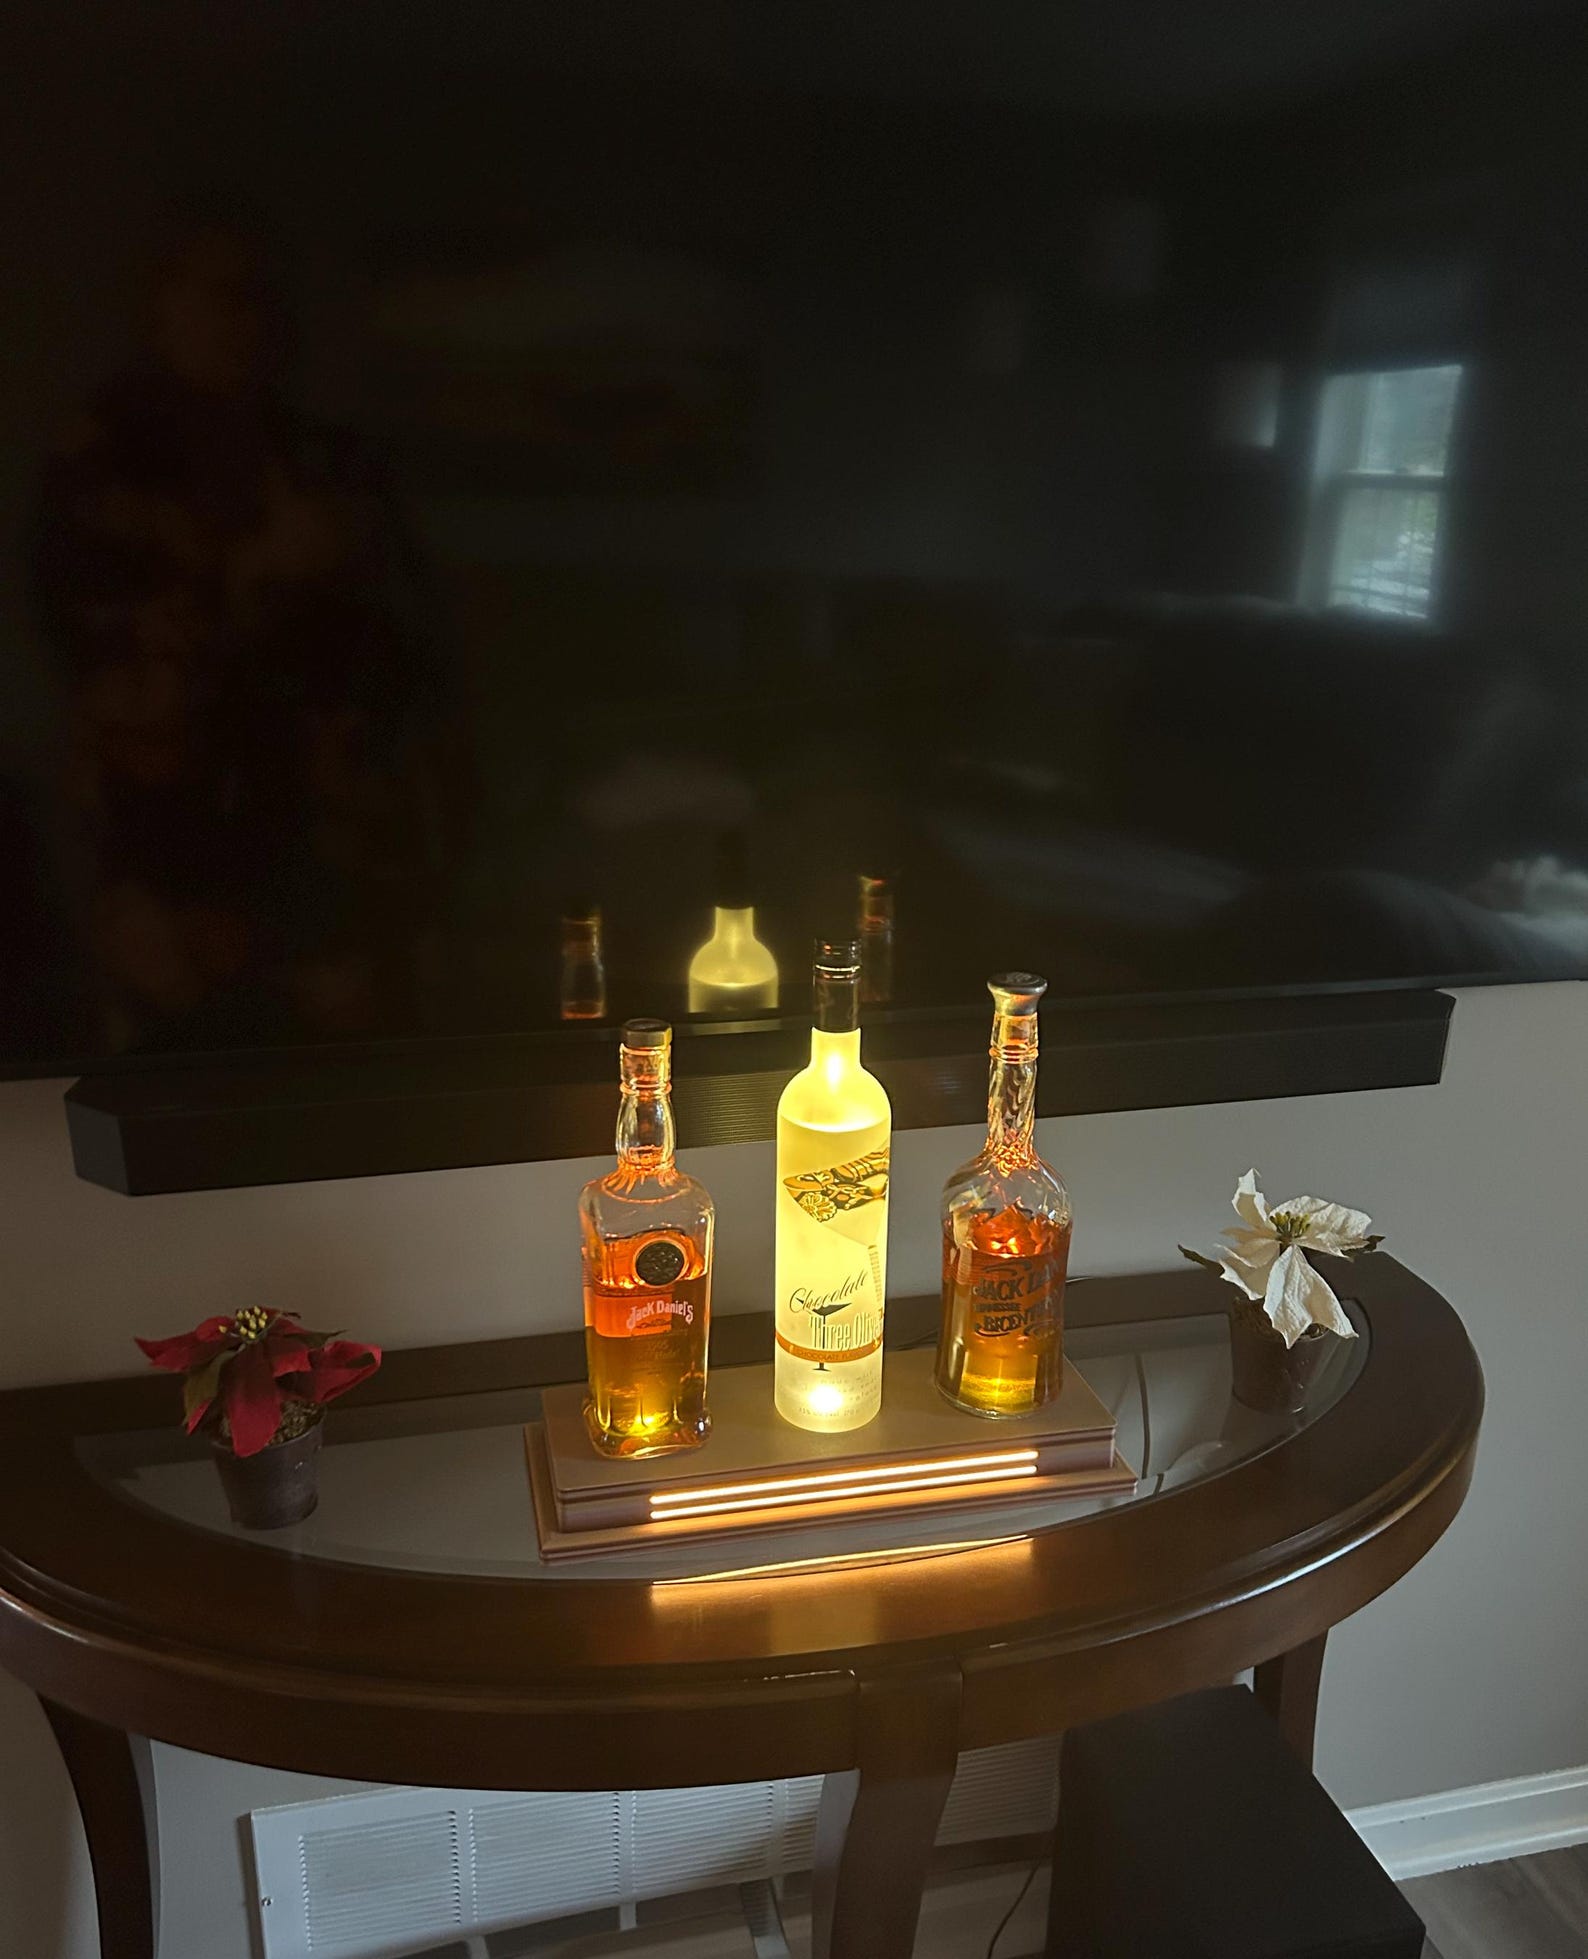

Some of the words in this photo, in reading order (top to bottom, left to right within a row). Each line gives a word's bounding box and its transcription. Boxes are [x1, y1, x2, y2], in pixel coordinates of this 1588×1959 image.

[973, 1276, 1024, 1300] JACK
[656, 1299, 694, 1325] Daniel's
[809, 1312, 852, 1351] Three
